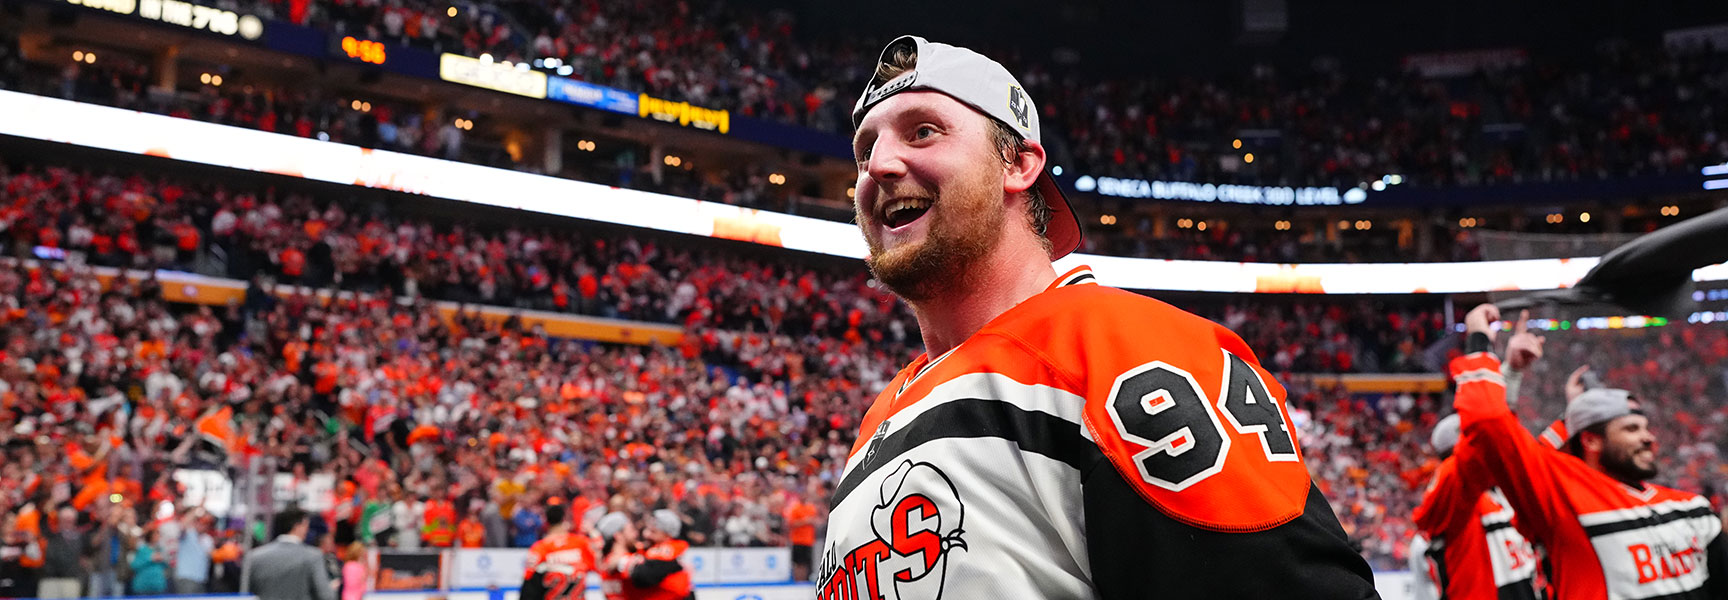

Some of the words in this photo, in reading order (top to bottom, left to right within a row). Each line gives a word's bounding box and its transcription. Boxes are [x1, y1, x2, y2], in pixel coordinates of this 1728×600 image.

[192, 5, 238, 36] 716
[1097, 176, 1151, 198] SENECA
[1151, 180, 1217, 202] BUFFALO
[1296, 186, 1342, 206] LEVEL
[1105, 347, 1299, 492] 94
